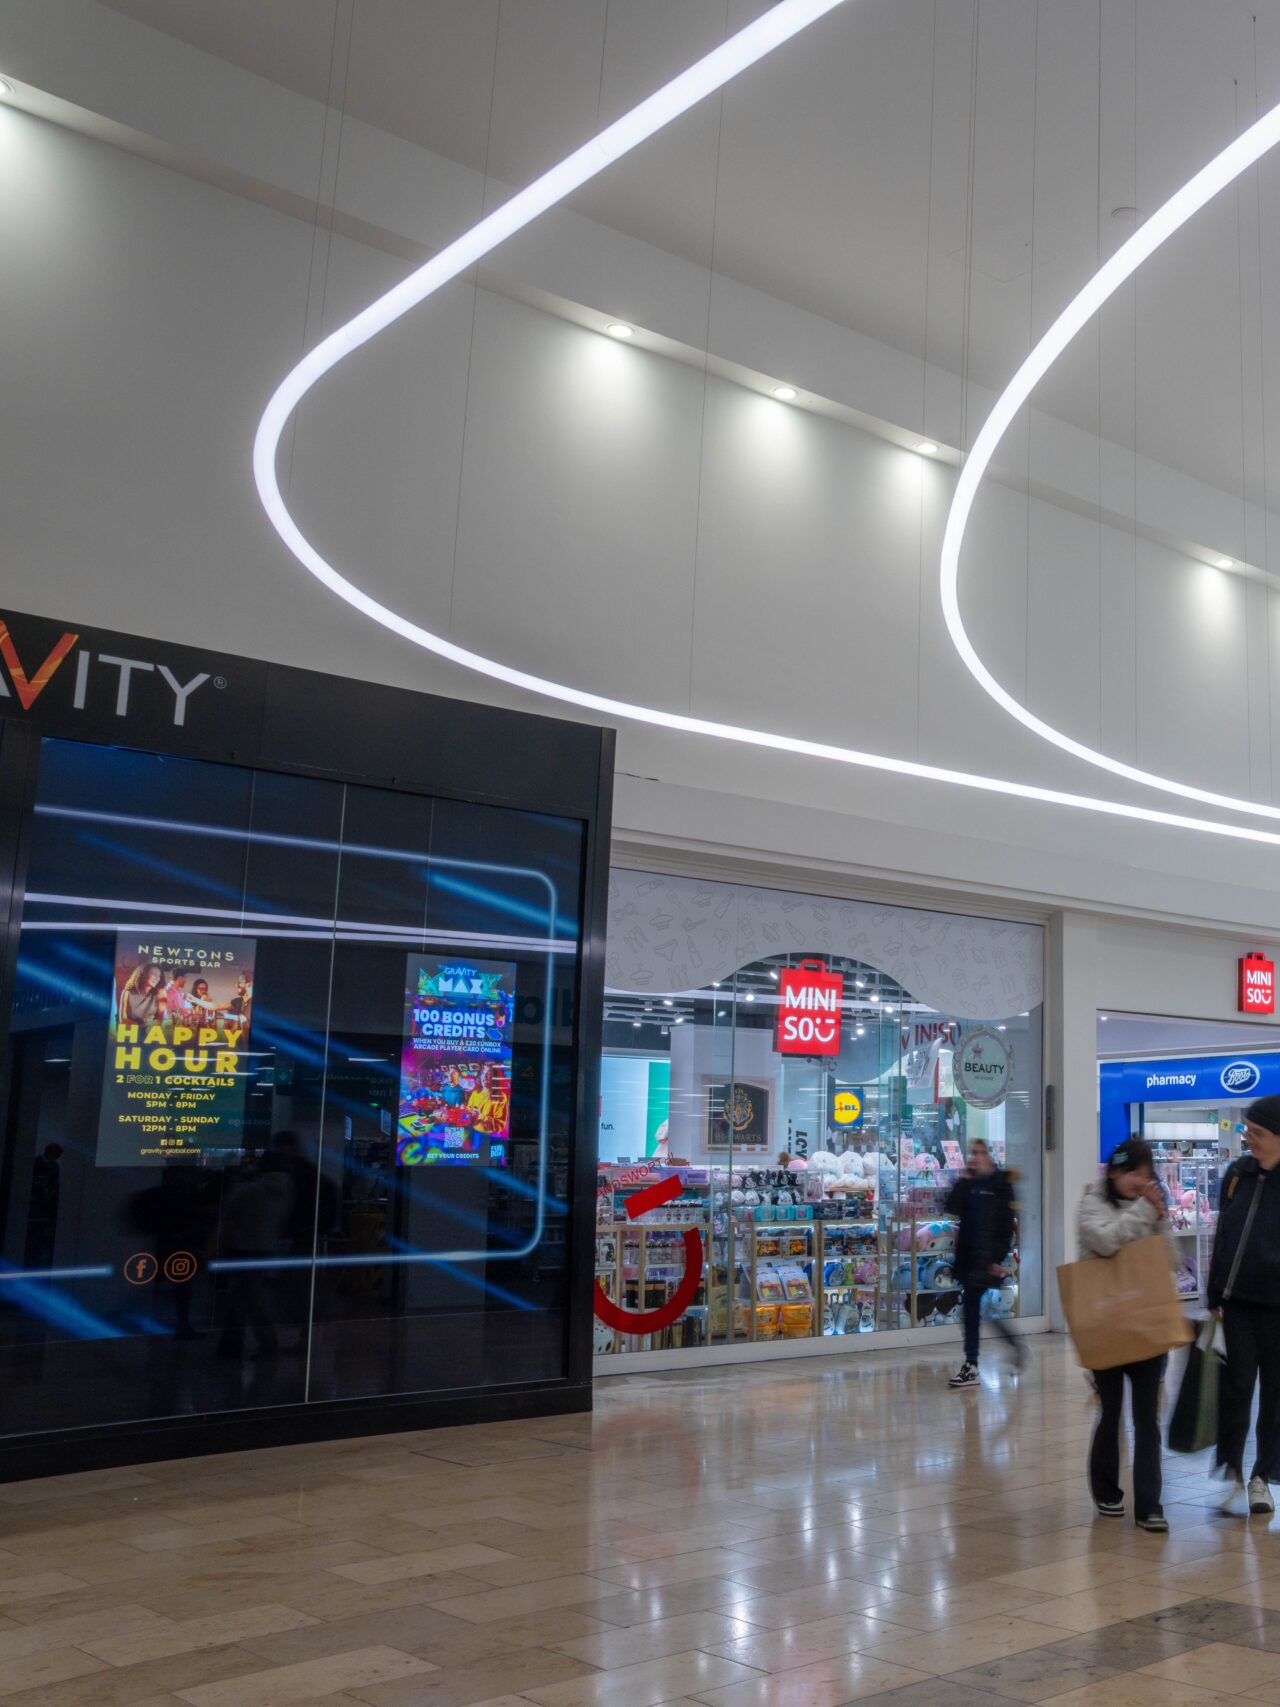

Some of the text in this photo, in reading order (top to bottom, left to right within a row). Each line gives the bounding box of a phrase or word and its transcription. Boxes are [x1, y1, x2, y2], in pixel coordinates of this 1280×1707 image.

[0, 619, 212, 727] VITY
[137, 944, 235, 962] NEWTONS
[152, 956, 221, 968] SPORTS BAR
[444, 966, 477, 976] GRAVITY
[1246, 969, 1272, 986] MINI
[438, 976, 483, 994] MAX
[785, 985, 836, 1012] MINI
[413, 1008, 494, 1026] 100 BONUS
[116, 1024, 242, 1048] HAPPY
[422, 1024, 486, 1038] CREDITS
[414, 1043, 440, 1051] ARCADE
[440, 1044, 462, 1052] PLAYER
[480, 1046, 502, 1054] ONLINE
[115, 1046, 239, 1073] HOUR
[964, 1062, 1005, 1074] BEAUTY
[116, 1074, 124, 1084] 2
[126, 1075, 153, 1084] FOR
[164, 1077, 235, 1086] COCKTAILS
[1146, 1074, 1196, 1088] pharmacy
[1226, 1068, 1252, 1086] Boots
[128, 1092, 172, 1100] MONDAY
[180, 1093, 216, 1101] FRIDAY
[146, 1100, 167, 1108] 5PM
[176, 1101, 197, 1109] 8PM
[118, 1115, 172, 1123] SATURDAY
[180, 1116, 220, 1124] SUNDAY
[142, 1124, 166, 1132] 12PM
[176, 1125, 197, 1133] 8PM
[601, 1122, 616, 1130] fun.
[140, 1148, 201, 1156] gravity-global.com
